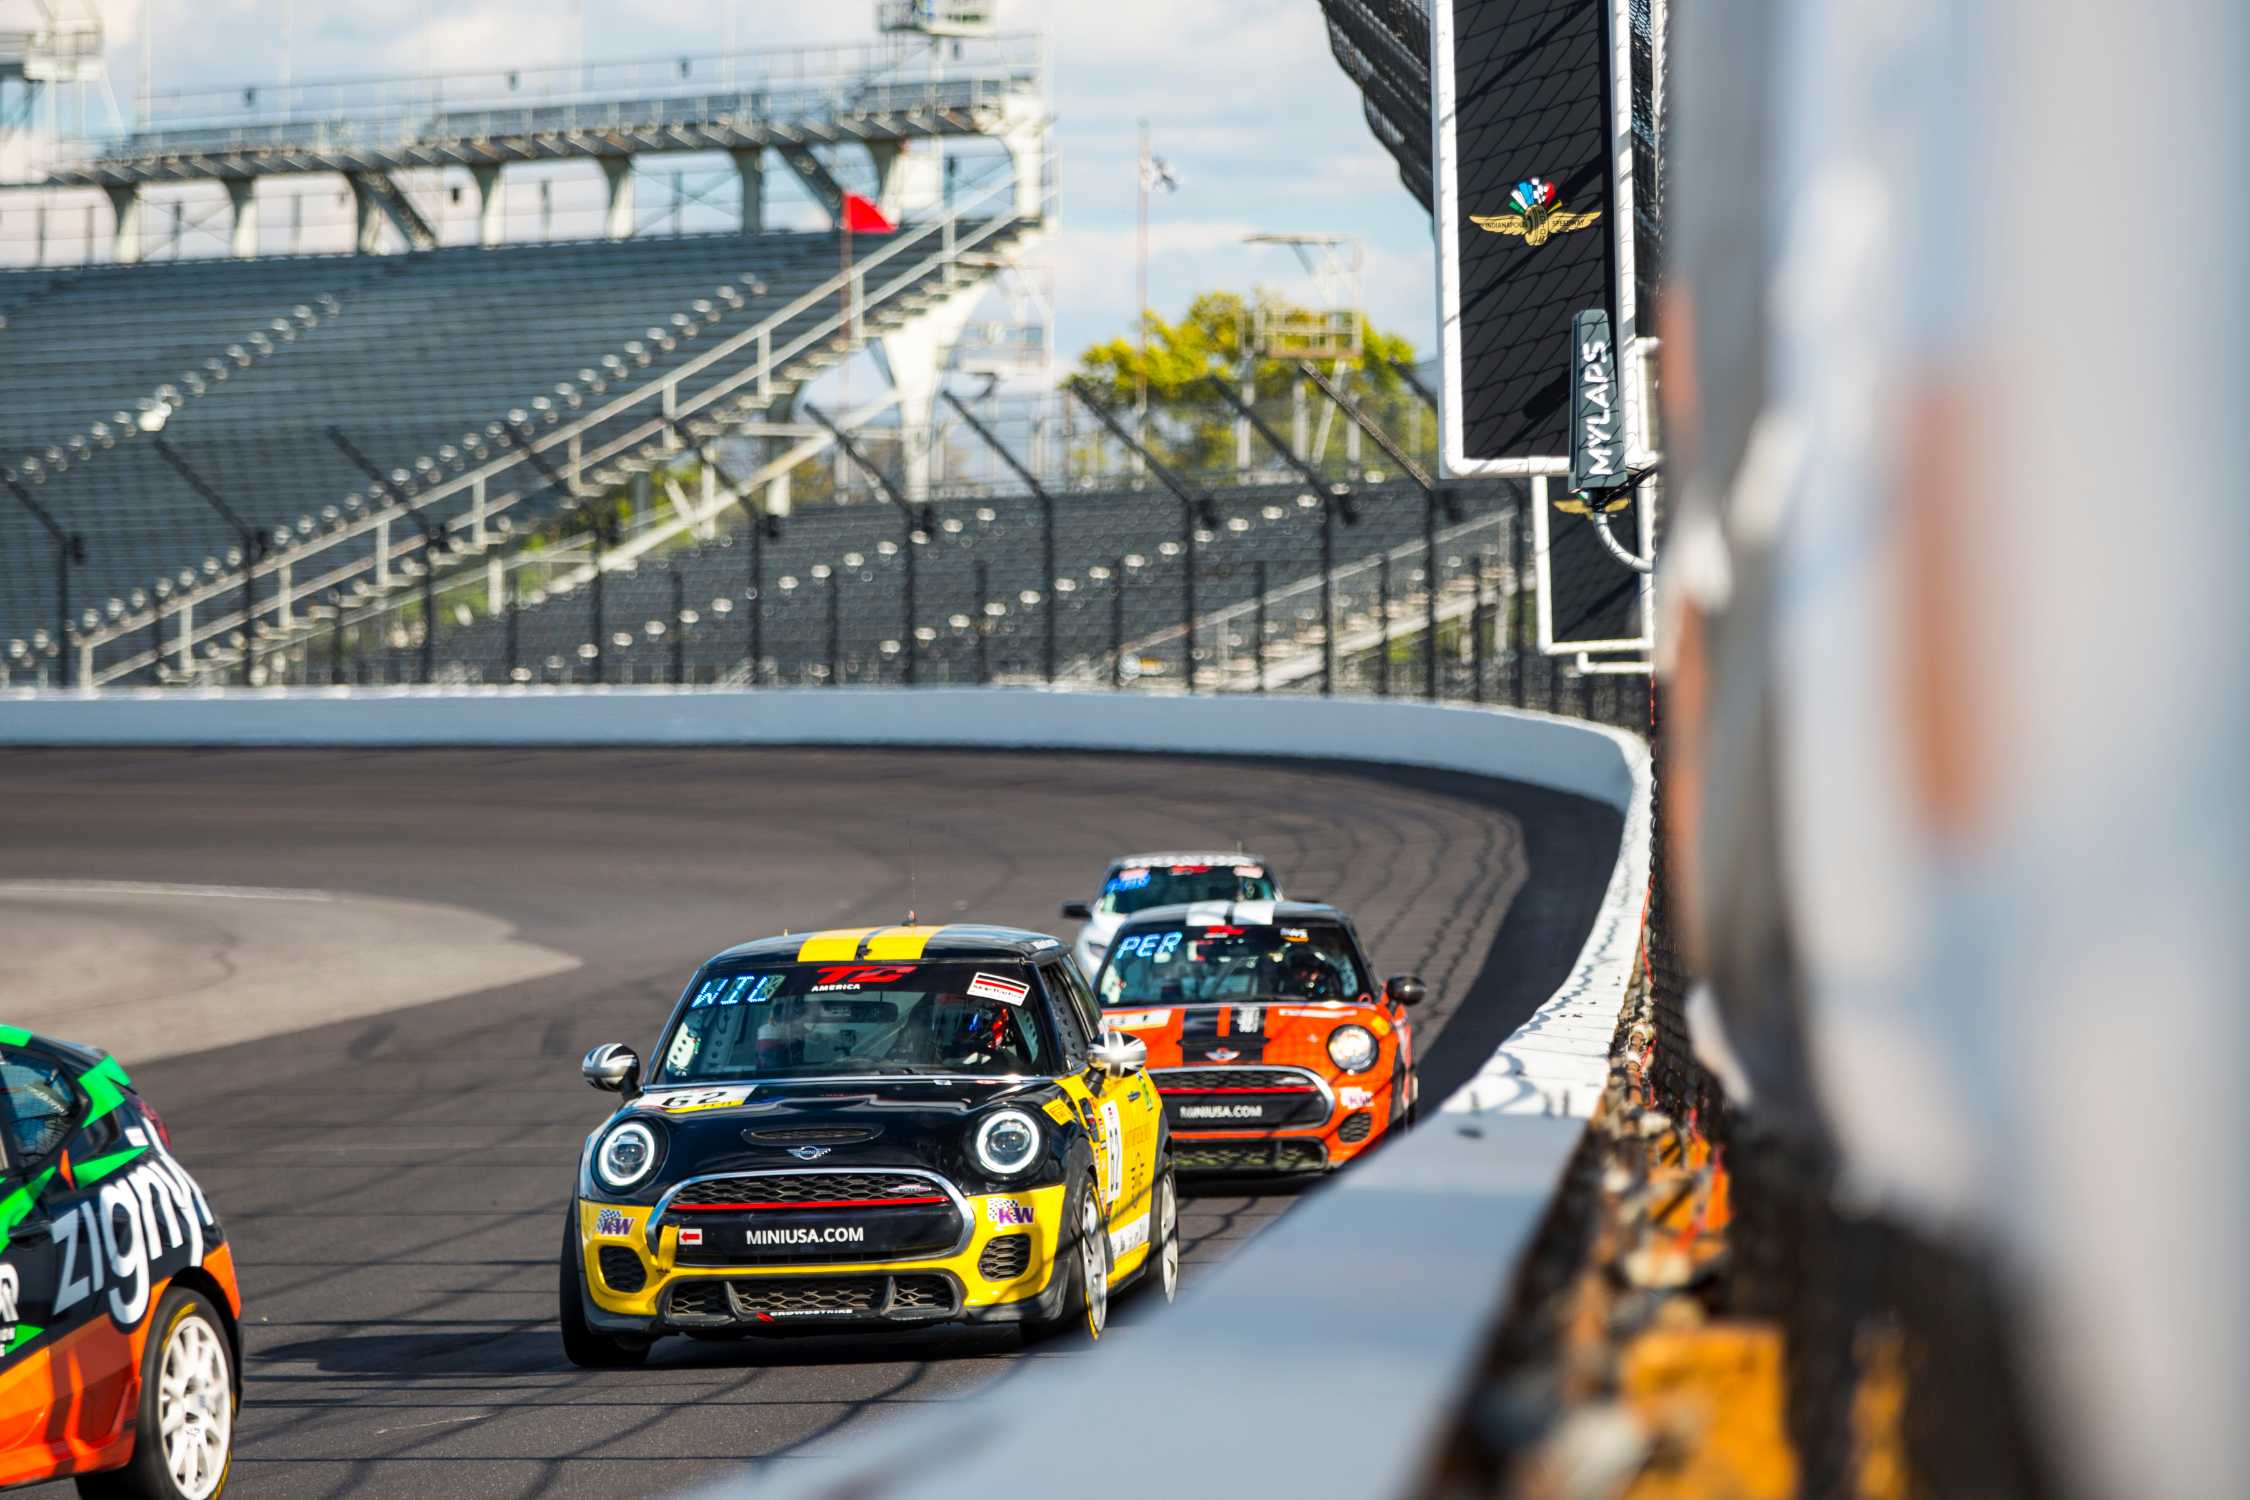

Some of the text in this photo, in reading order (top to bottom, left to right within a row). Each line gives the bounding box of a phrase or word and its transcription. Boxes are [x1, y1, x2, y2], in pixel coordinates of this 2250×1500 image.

[1582, 341, 1613, 475] MYLAPS
[1115, 931, 1183, 960] PER
[691, 975, 768, 1008] WIL
[811, 983, 861, 992] AMERICA
[661, 1091, 729, 1108] 62
[1179, 1105, 1263, 1119] MINIUSA.COM
[998, 1206, 1034, 1225] KW
[600, 1216, 635, 1236] KW
[745, 1226, 865, 1246] MINIUSA.COM
[769, 1309, 853, 1317] CROWDSTRIKE
